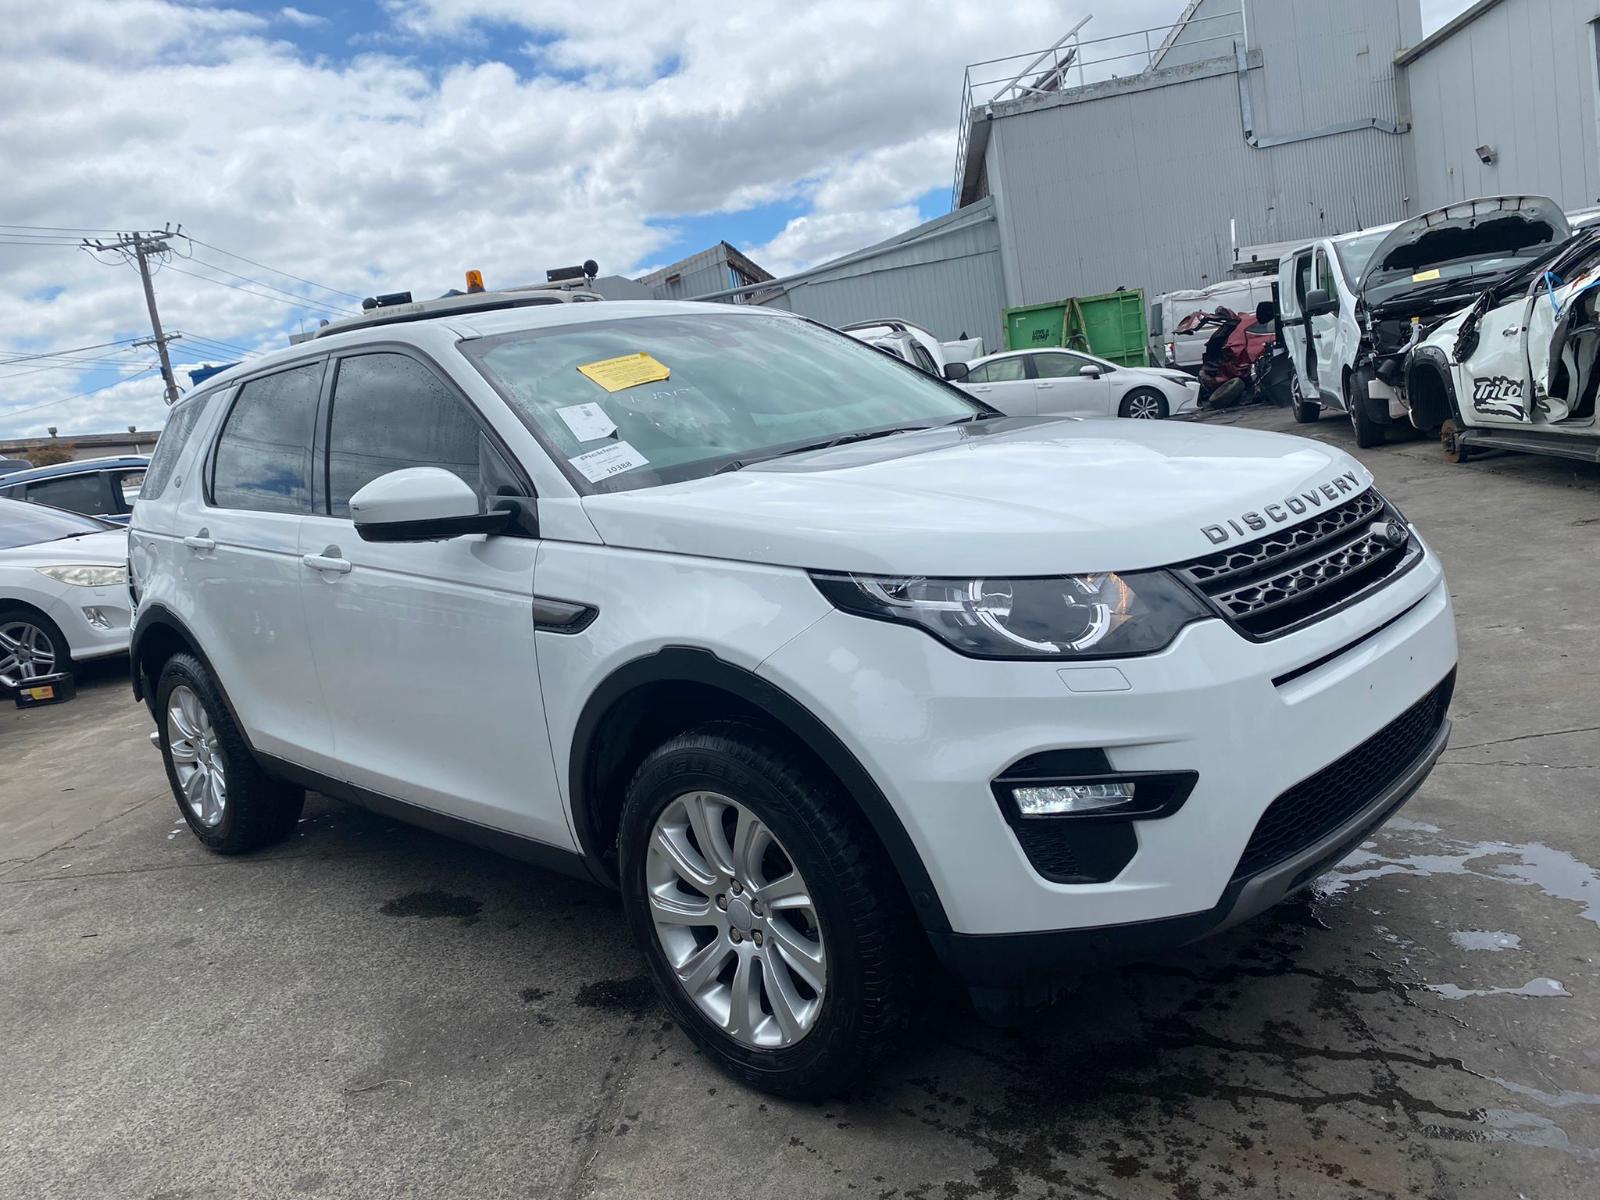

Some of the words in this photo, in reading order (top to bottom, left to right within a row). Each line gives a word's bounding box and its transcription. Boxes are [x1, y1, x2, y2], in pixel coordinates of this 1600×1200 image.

[1474, 377, 1524, 400] Trito
[606, 461, 633, 474] 10388
[1200, 470, 1360, 544] DISCOVERY
